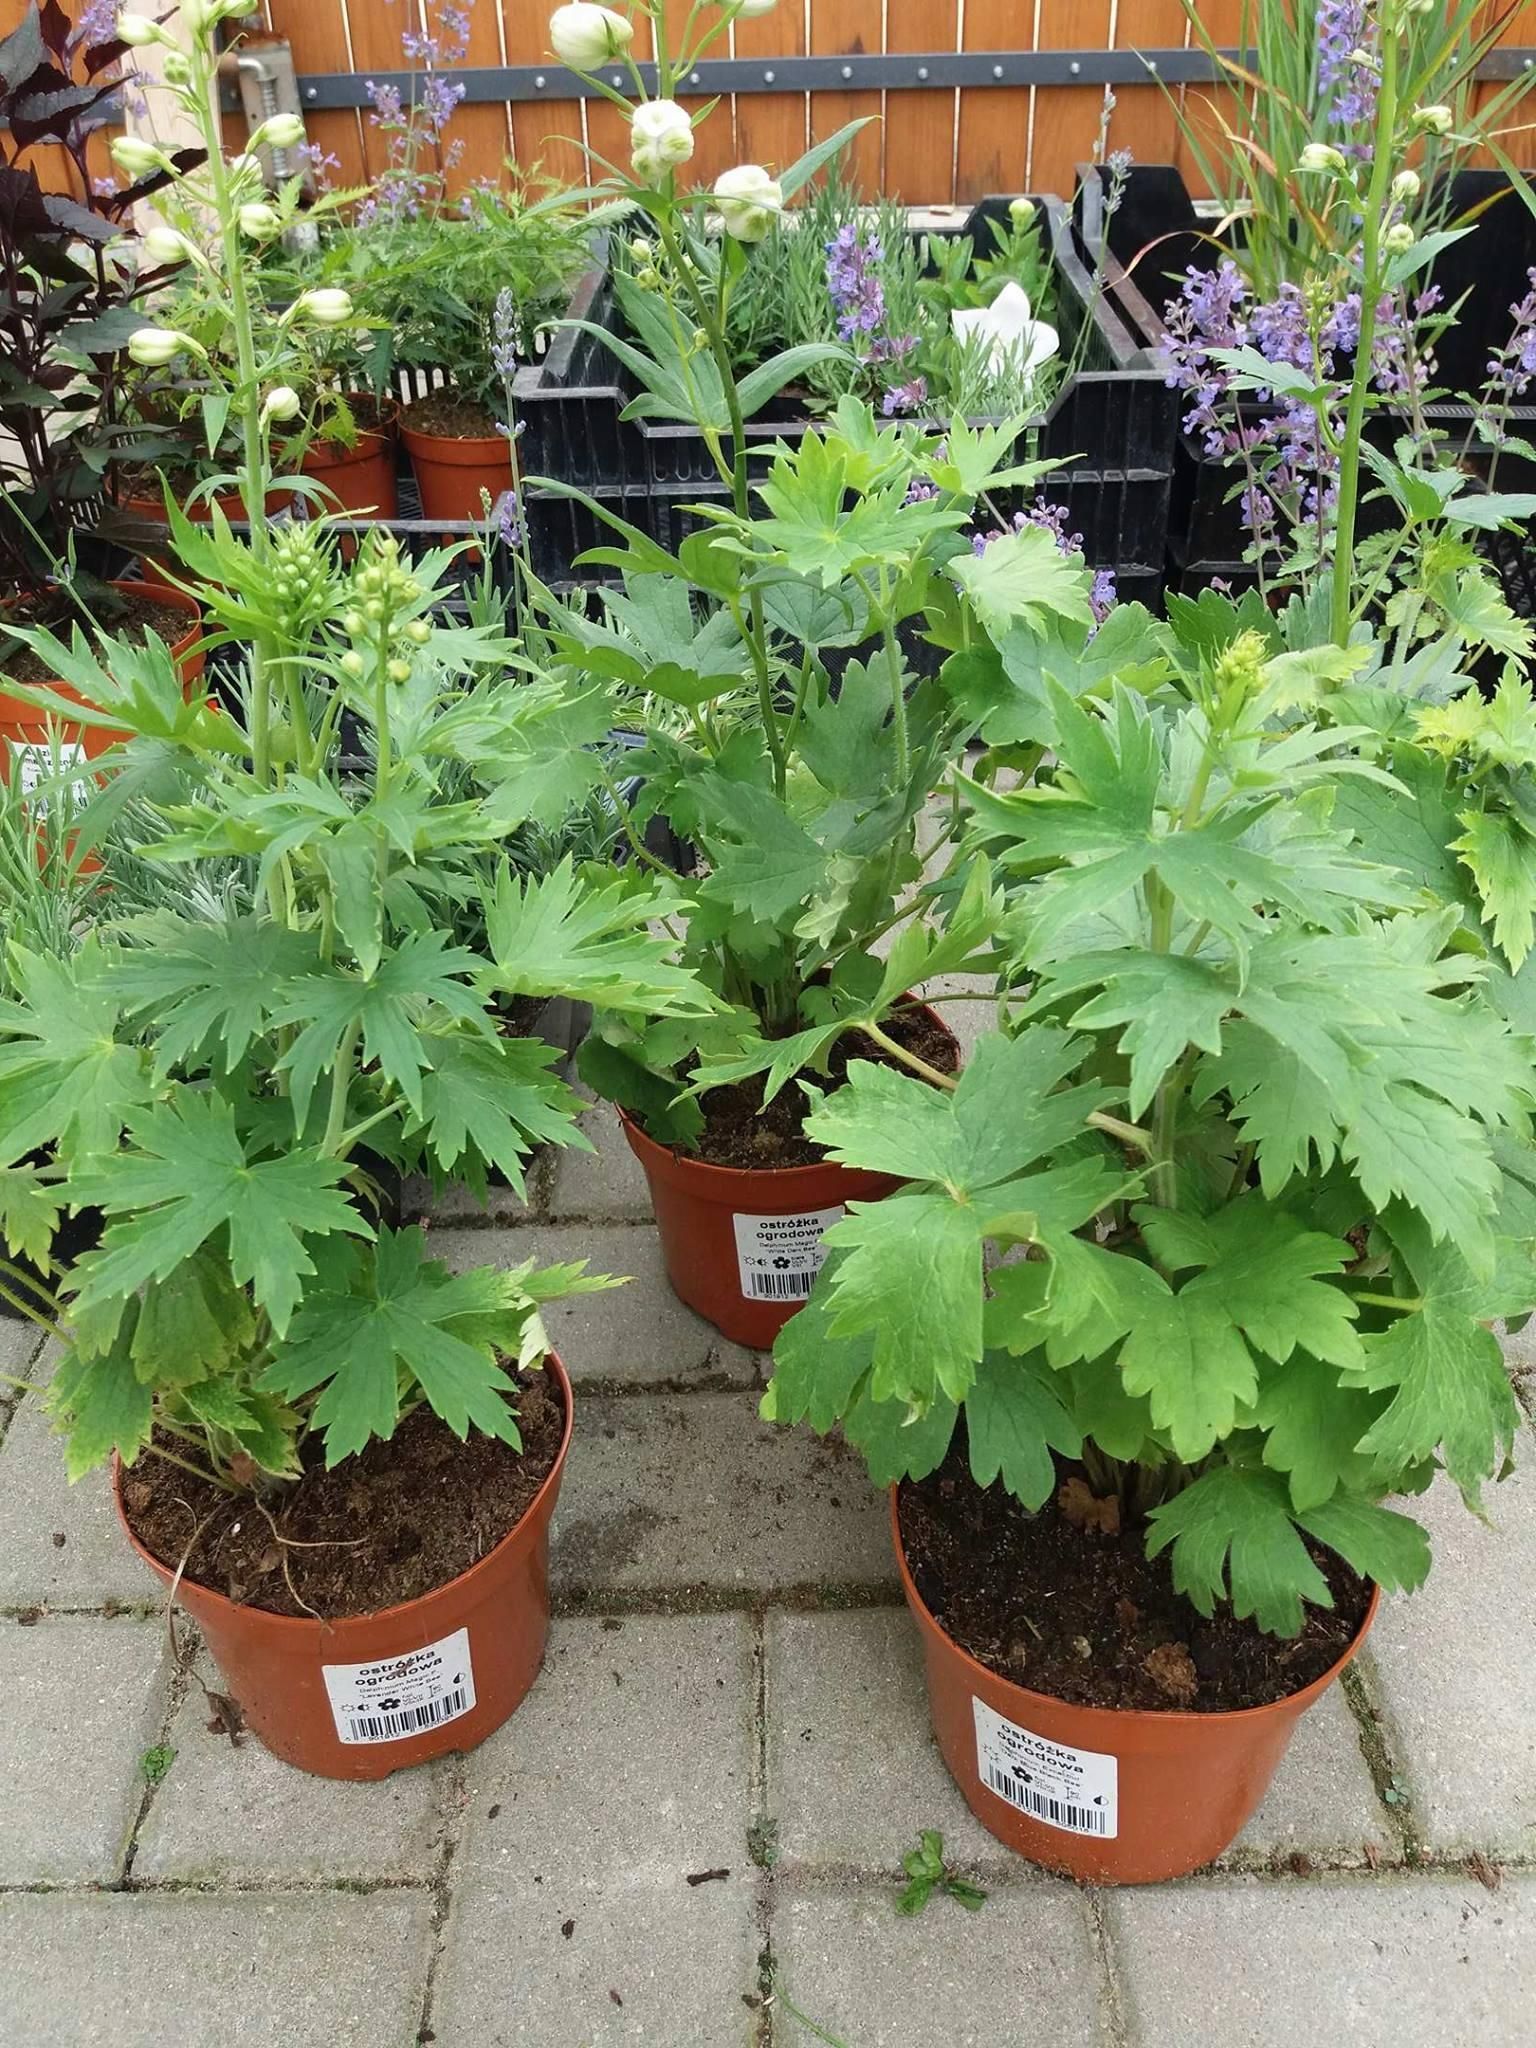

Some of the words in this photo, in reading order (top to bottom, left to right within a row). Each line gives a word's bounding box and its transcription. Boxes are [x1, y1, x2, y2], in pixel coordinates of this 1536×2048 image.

[756, 1227, 824, 1241] ogrodowa
[760, 1218, 819, 1230] ostróżka
[355, 1658, 442, 1686] ogrodowa
[359, 1651, 435, 1676] ostróżka
[997, 1731, 1084, 1774] ogrodowa
[1001, 1724, 1077, 1762] ostróżka
